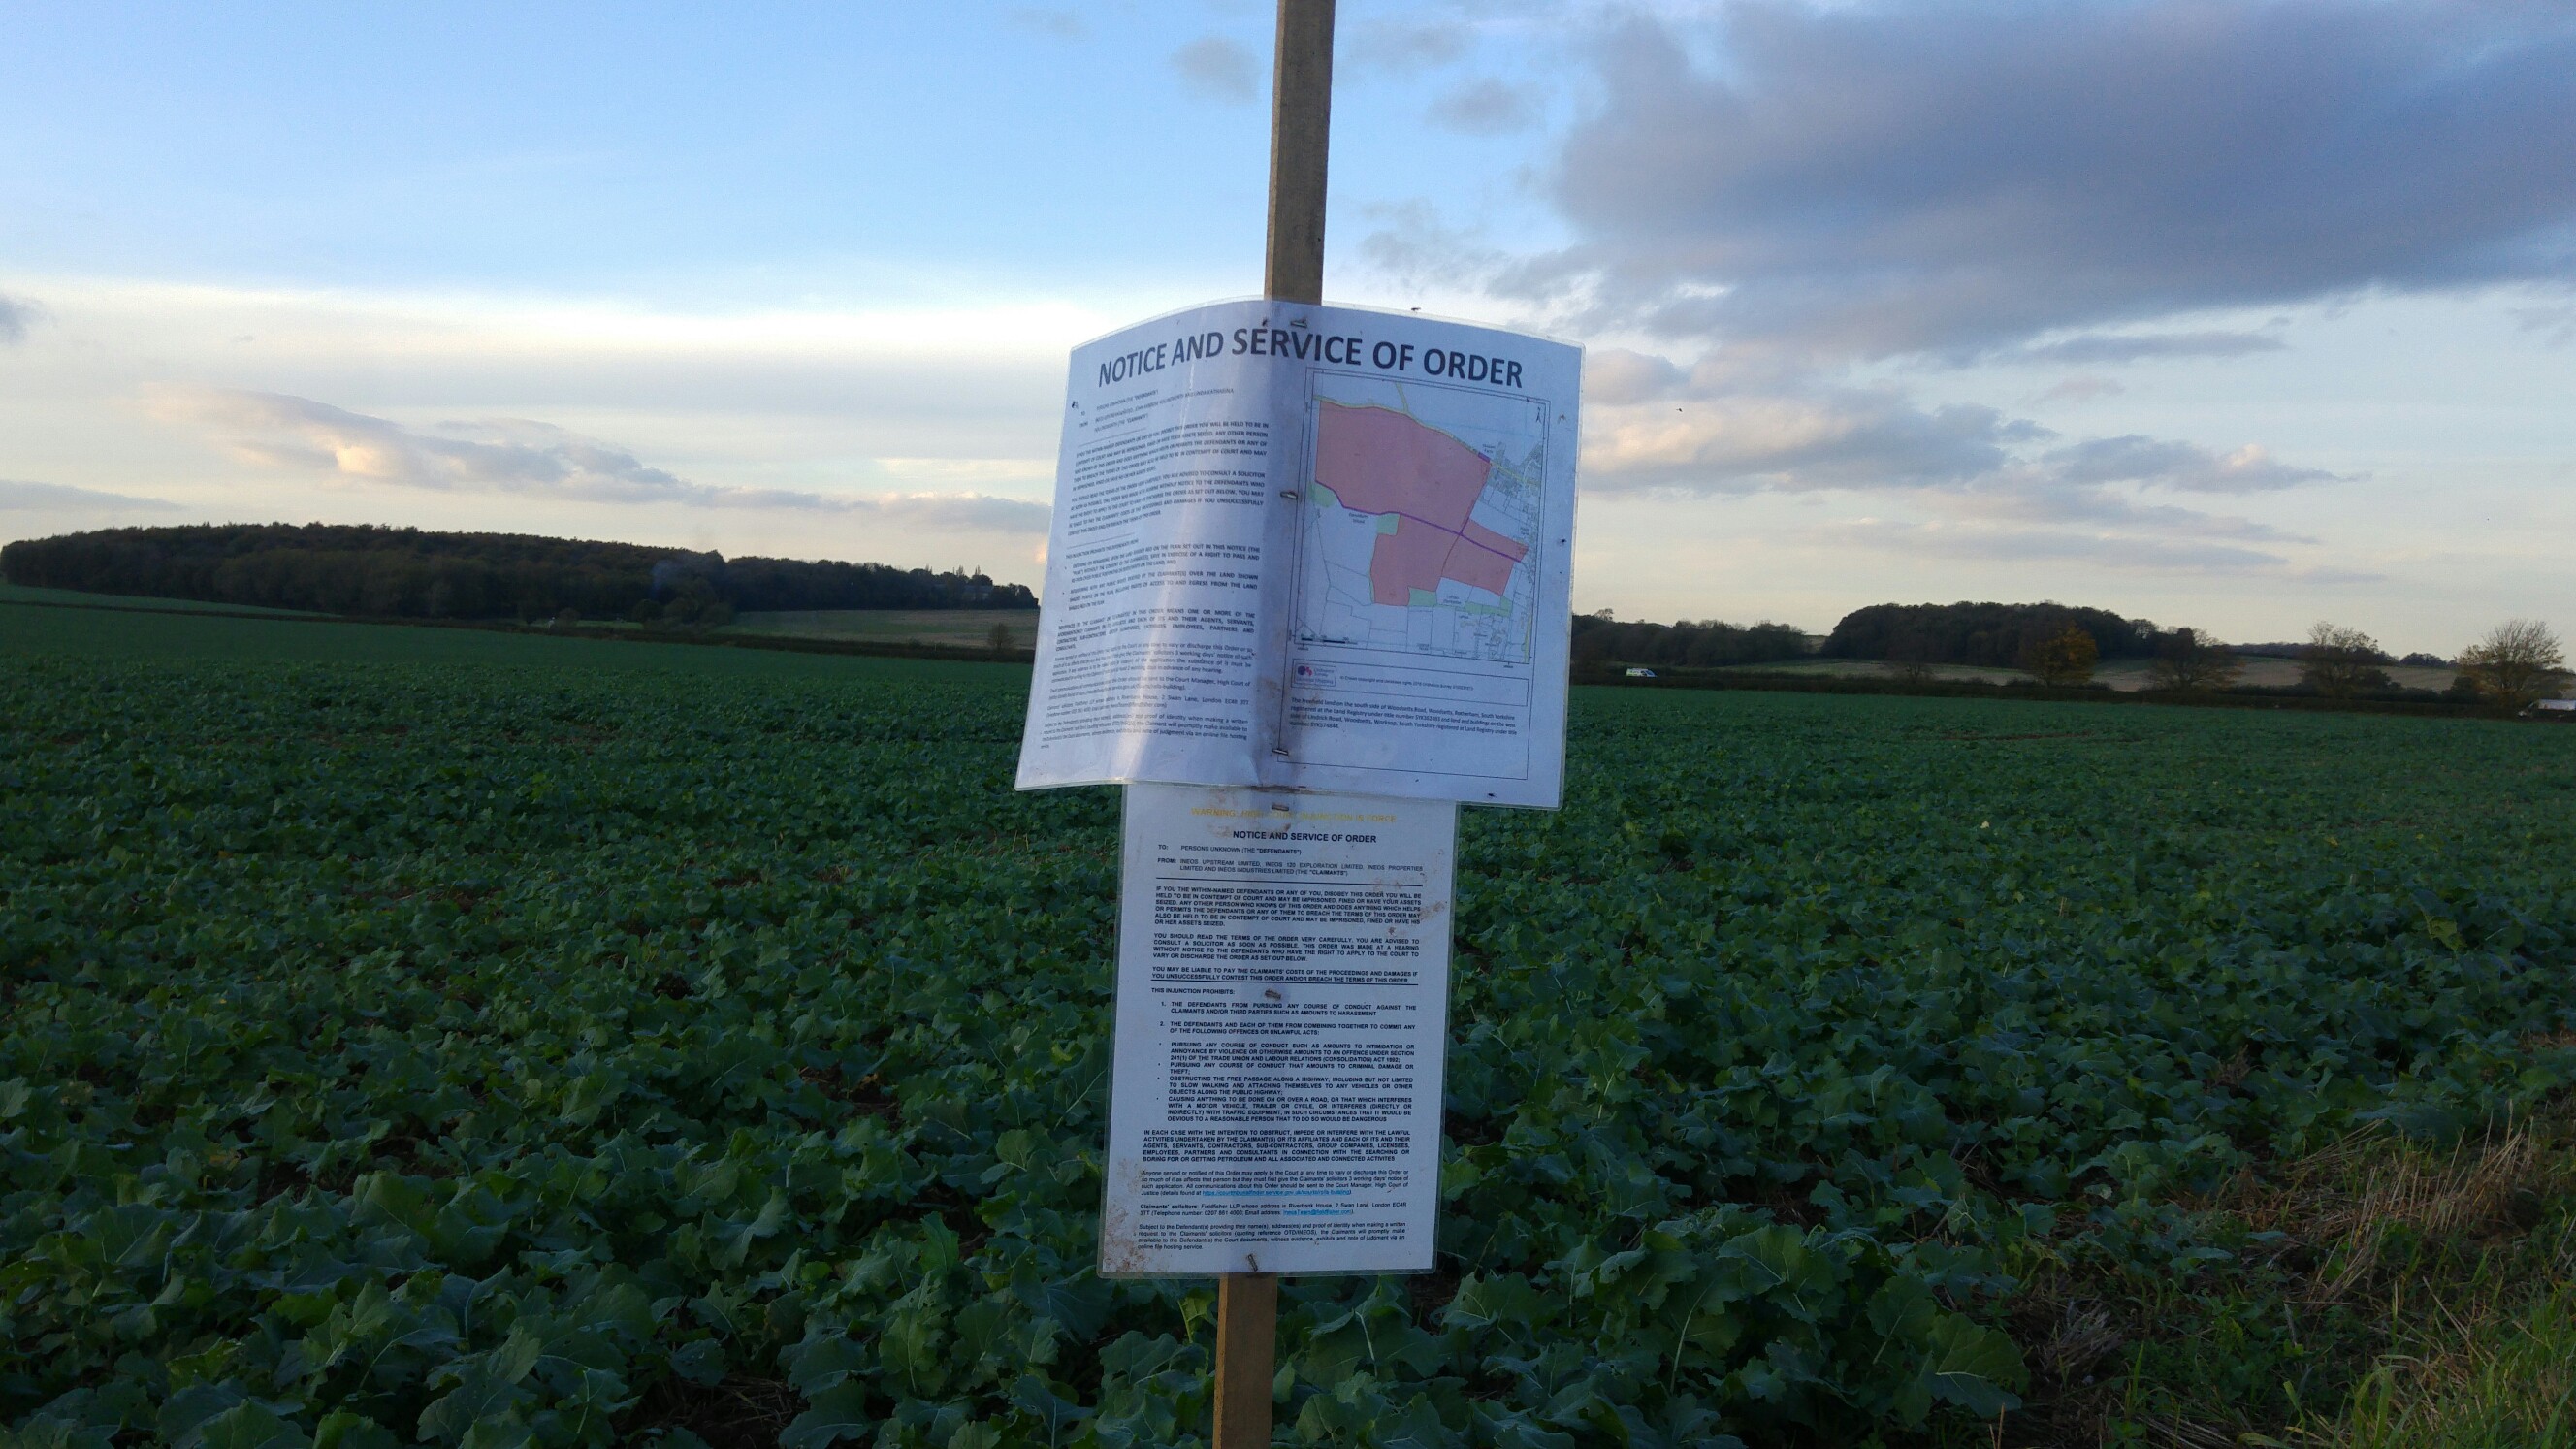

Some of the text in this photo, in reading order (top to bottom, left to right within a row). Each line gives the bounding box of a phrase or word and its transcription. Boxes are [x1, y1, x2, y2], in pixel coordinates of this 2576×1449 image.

[1099, 328, 1523, 388] NOTICE AND SERVICE OF ORDER
[1233, 830, 1267, 839] NOTICE
[1290, 832, 1329, 841] SERVICE
